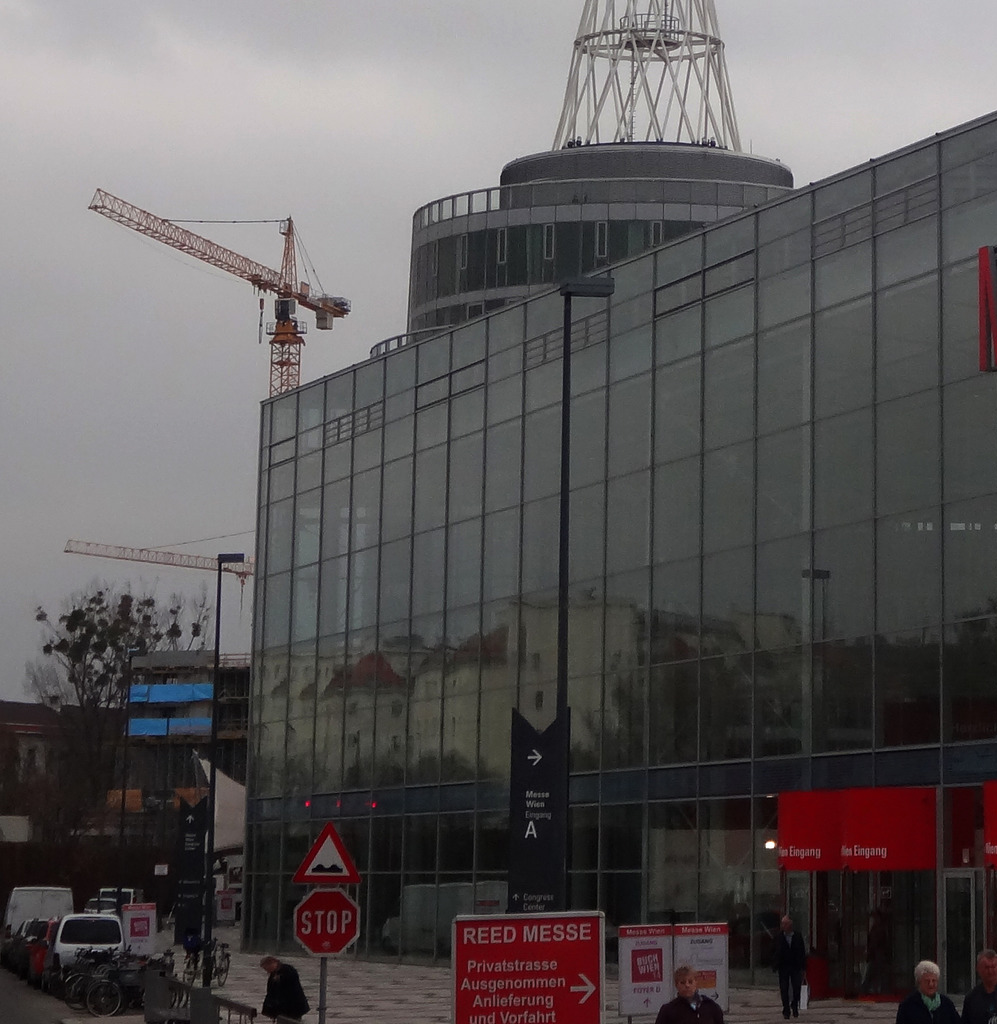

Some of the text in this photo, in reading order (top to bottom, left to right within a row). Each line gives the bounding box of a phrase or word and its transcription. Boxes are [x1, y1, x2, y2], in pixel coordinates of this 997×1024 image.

[525, 790, 550, 799] Messe
[525, 800, 545, 808] Wien
[525, 810, 552, 820] Eingang
[524, 820, 538, 839] A
[789, 846, 821, 859] Eingang
[853, 845, 887, 859] Eingang
[301, 910, 352, 936] STOP
[463, 923, 592, 944] REED MESSE
[467, 960, 558, 973] Privatstrasse
[460, 977, 566, 993] Ausgenommen
[472, 994, 554, 1009] Anlieferung
[469, 1010, 557, 1024] und Vorfahrt
